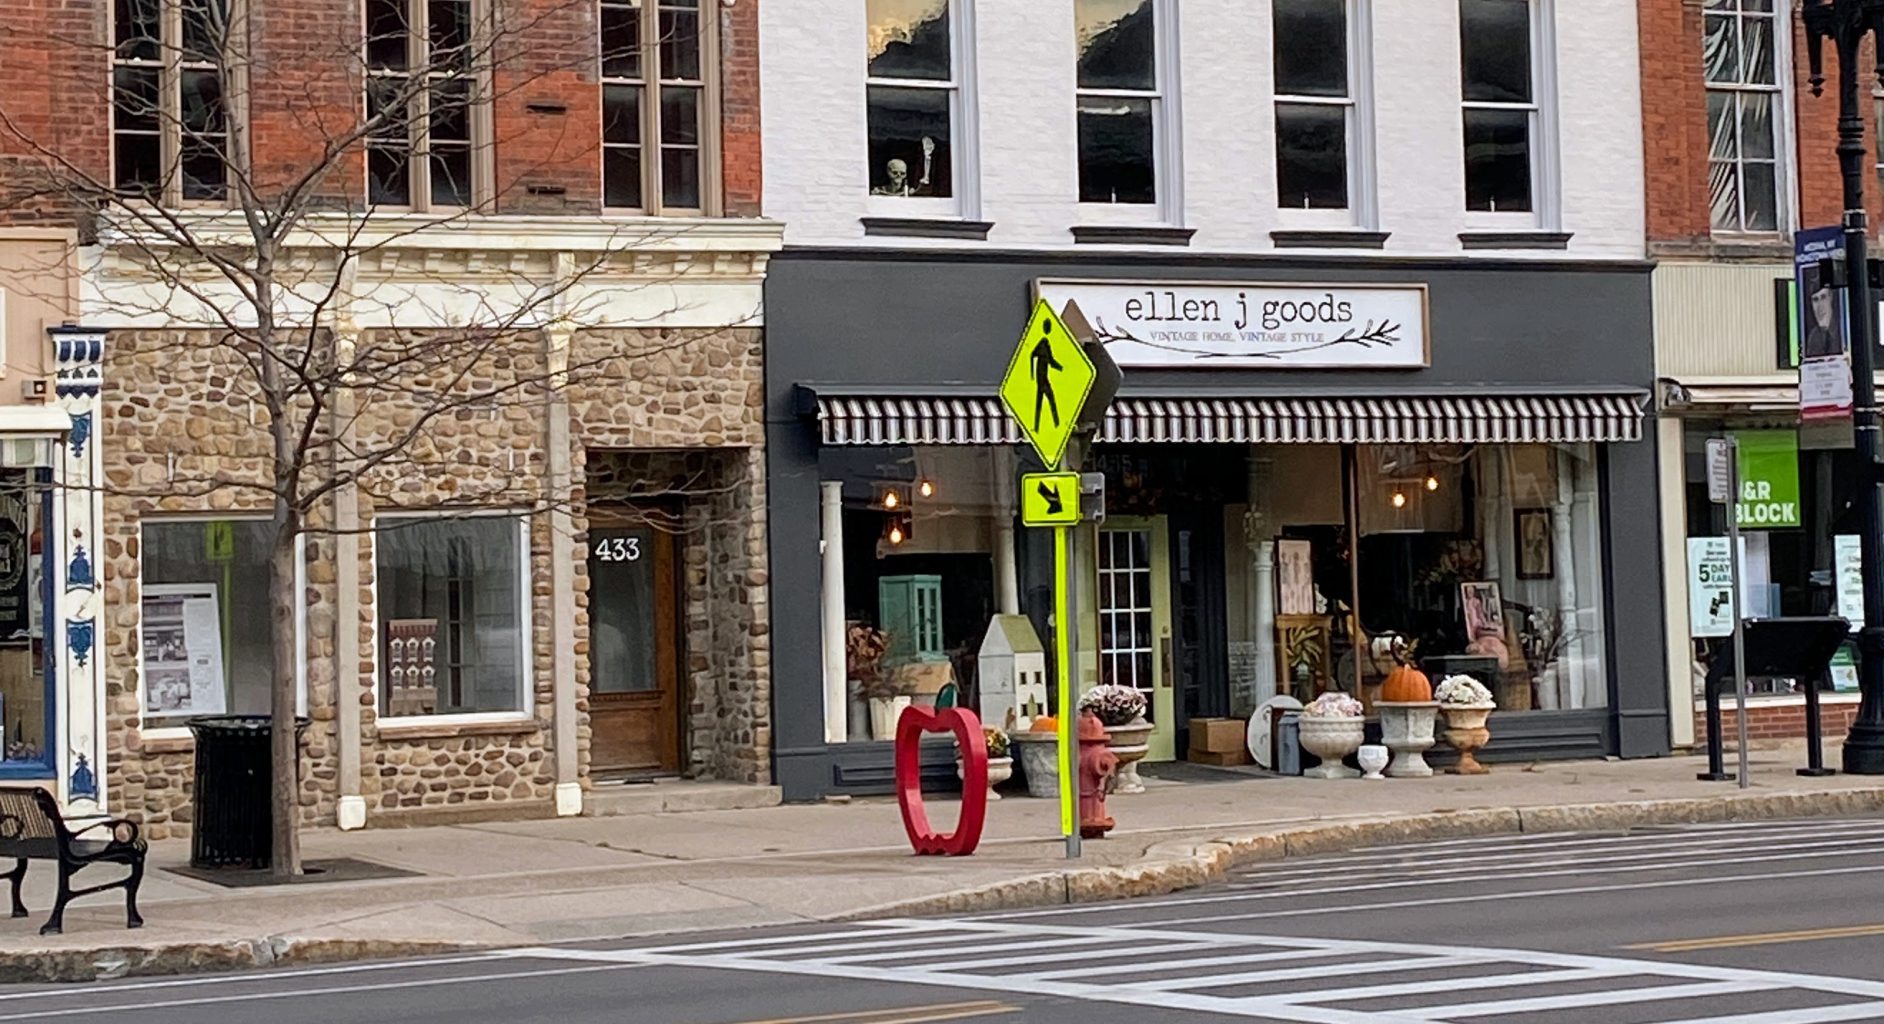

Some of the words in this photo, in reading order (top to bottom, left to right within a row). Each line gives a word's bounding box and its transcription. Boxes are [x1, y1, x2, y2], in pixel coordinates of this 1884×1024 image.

[1125, 291, 1221, 321] ellen
[1234, 292, 1247, 330] j
[1262, 293, 1353, 330] goods
[1150, 331, 1199, 342] VINTAGE
[1240, 332, 1287, 343] VINTAGE
[1290, 333, 1325, 343] STYLE
[1735, 502, 1796, 524] BLOCK
[595, 538, 640, 561] 433
[1699, 564, 1710, 582] 5
[1711, 564, 1731, 573] DAY
[1711, 574, 1734, 583] EARL
